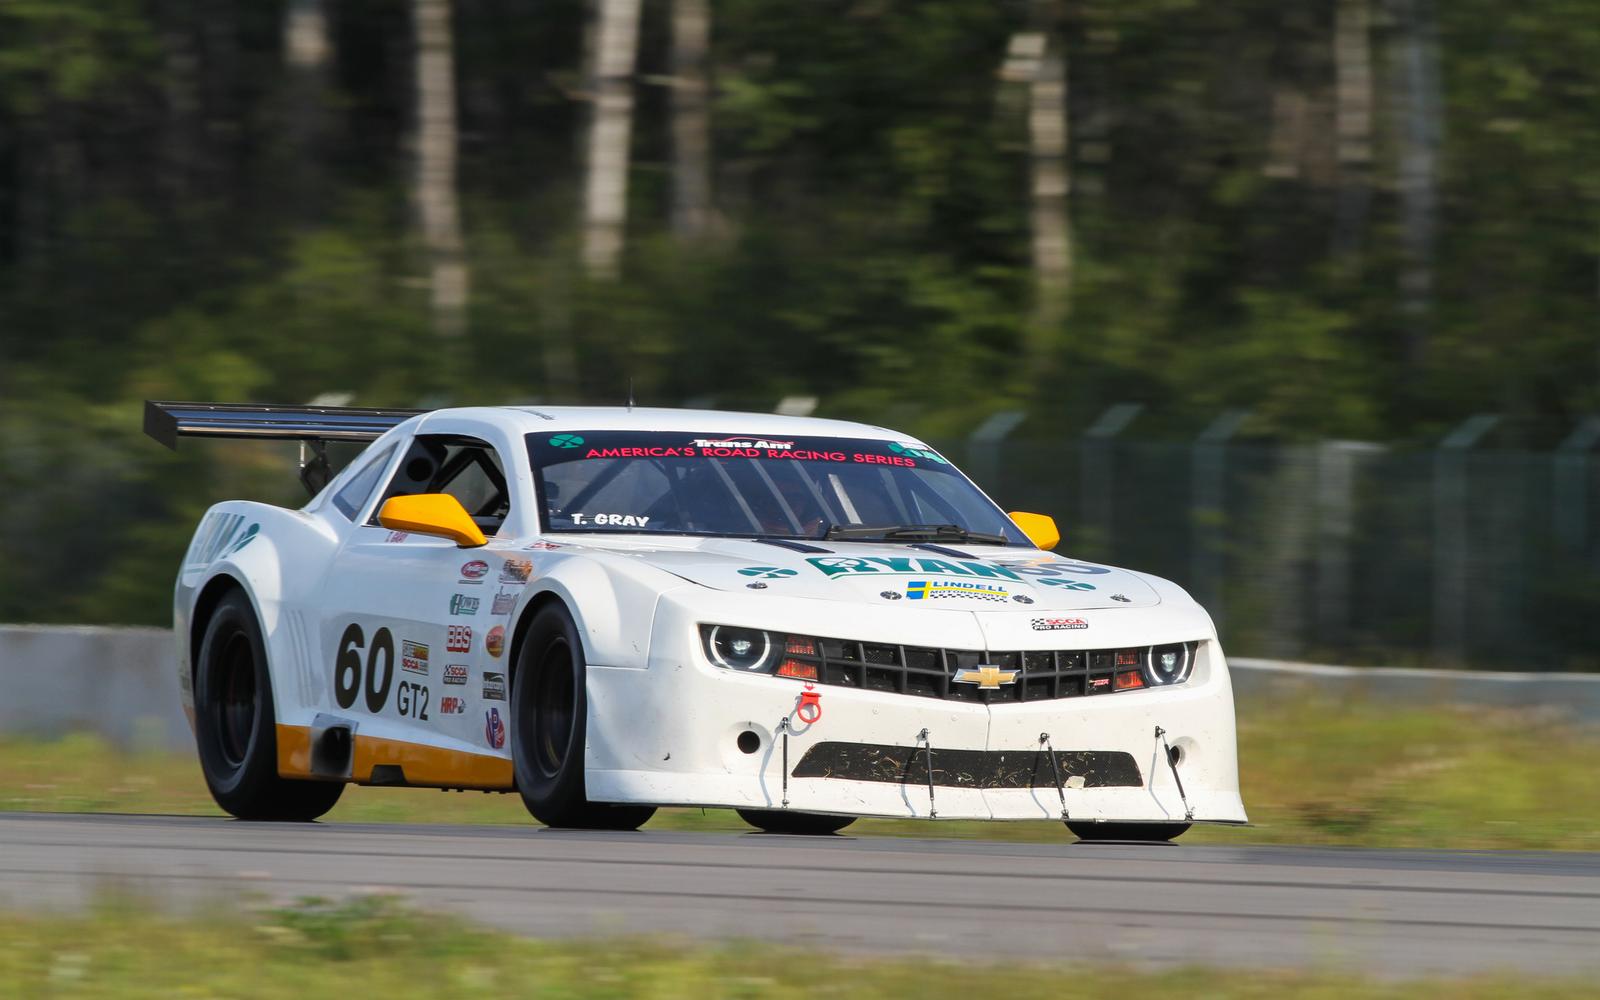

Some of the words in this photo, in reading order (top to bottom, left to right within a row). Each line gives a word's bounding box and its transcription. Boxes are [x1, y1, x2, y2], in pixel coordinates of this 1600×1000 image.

[693, 439, 752, 448] Trans
[754, 440, 791, 449] Am
[586, 447, 695, 458] AMERICA'S
[702, 447, 760, 457] ROAD
[767, 449, 846, 461] RACING
[853, 453, 917, 467] SERIES
[571, 513, 587, 525] T.
[594, 513, 650, 527] GRAY
[804, 557, 1024, 580] RYAN
[929, 590, 1008, 599] MOTORSPORTS
[932, 581, 1008, 592] LINDELL
[446, 625, 472, 652] BBS
[334, 623, 395, 713] 60
[450, 666, 467, 676] SCCA
[397, 681, 430, 721] GT2
[441, 696, 458, 714] HRP
